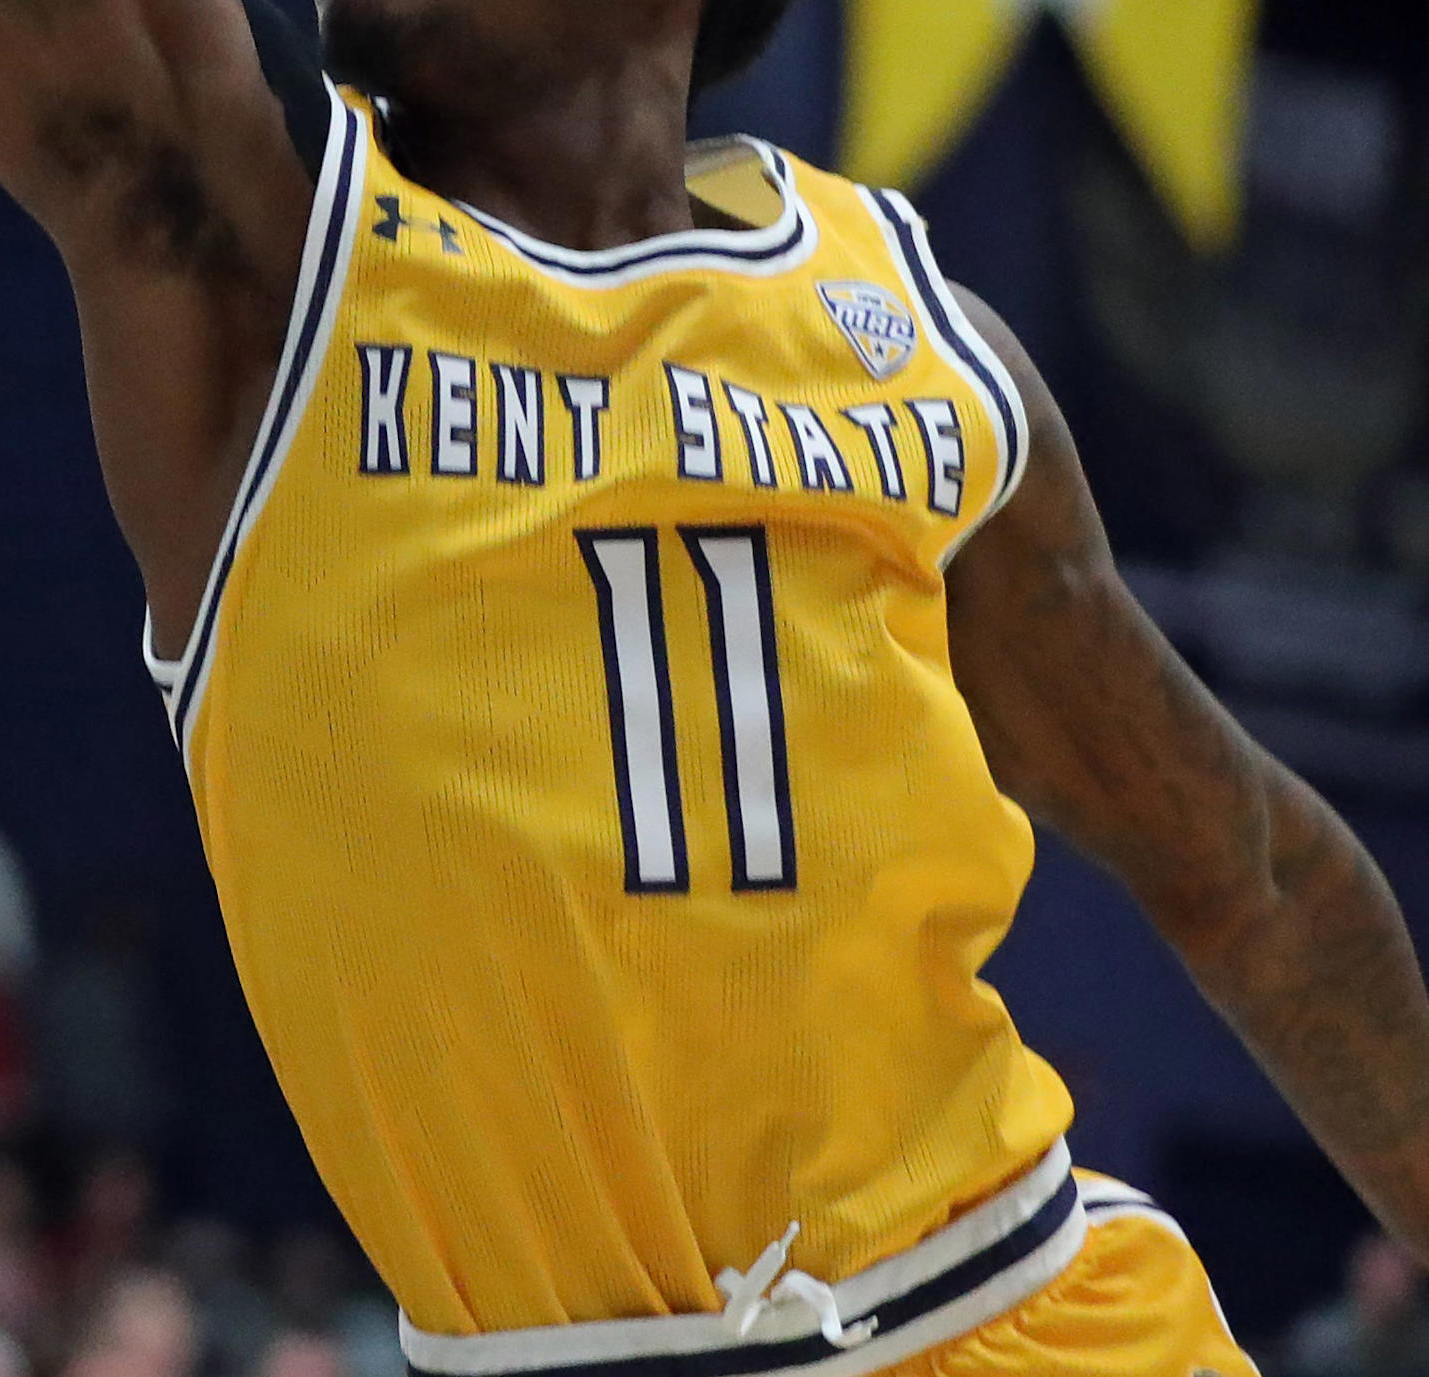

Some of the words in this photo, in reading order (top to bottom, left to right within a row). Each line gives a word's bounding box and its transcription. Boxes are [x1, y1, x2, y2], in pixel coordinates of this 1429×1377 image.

[355, 342, 610, 487] KENT
[662, 359, 966, 519] STATE
[572, 525, 798, 894] 11
